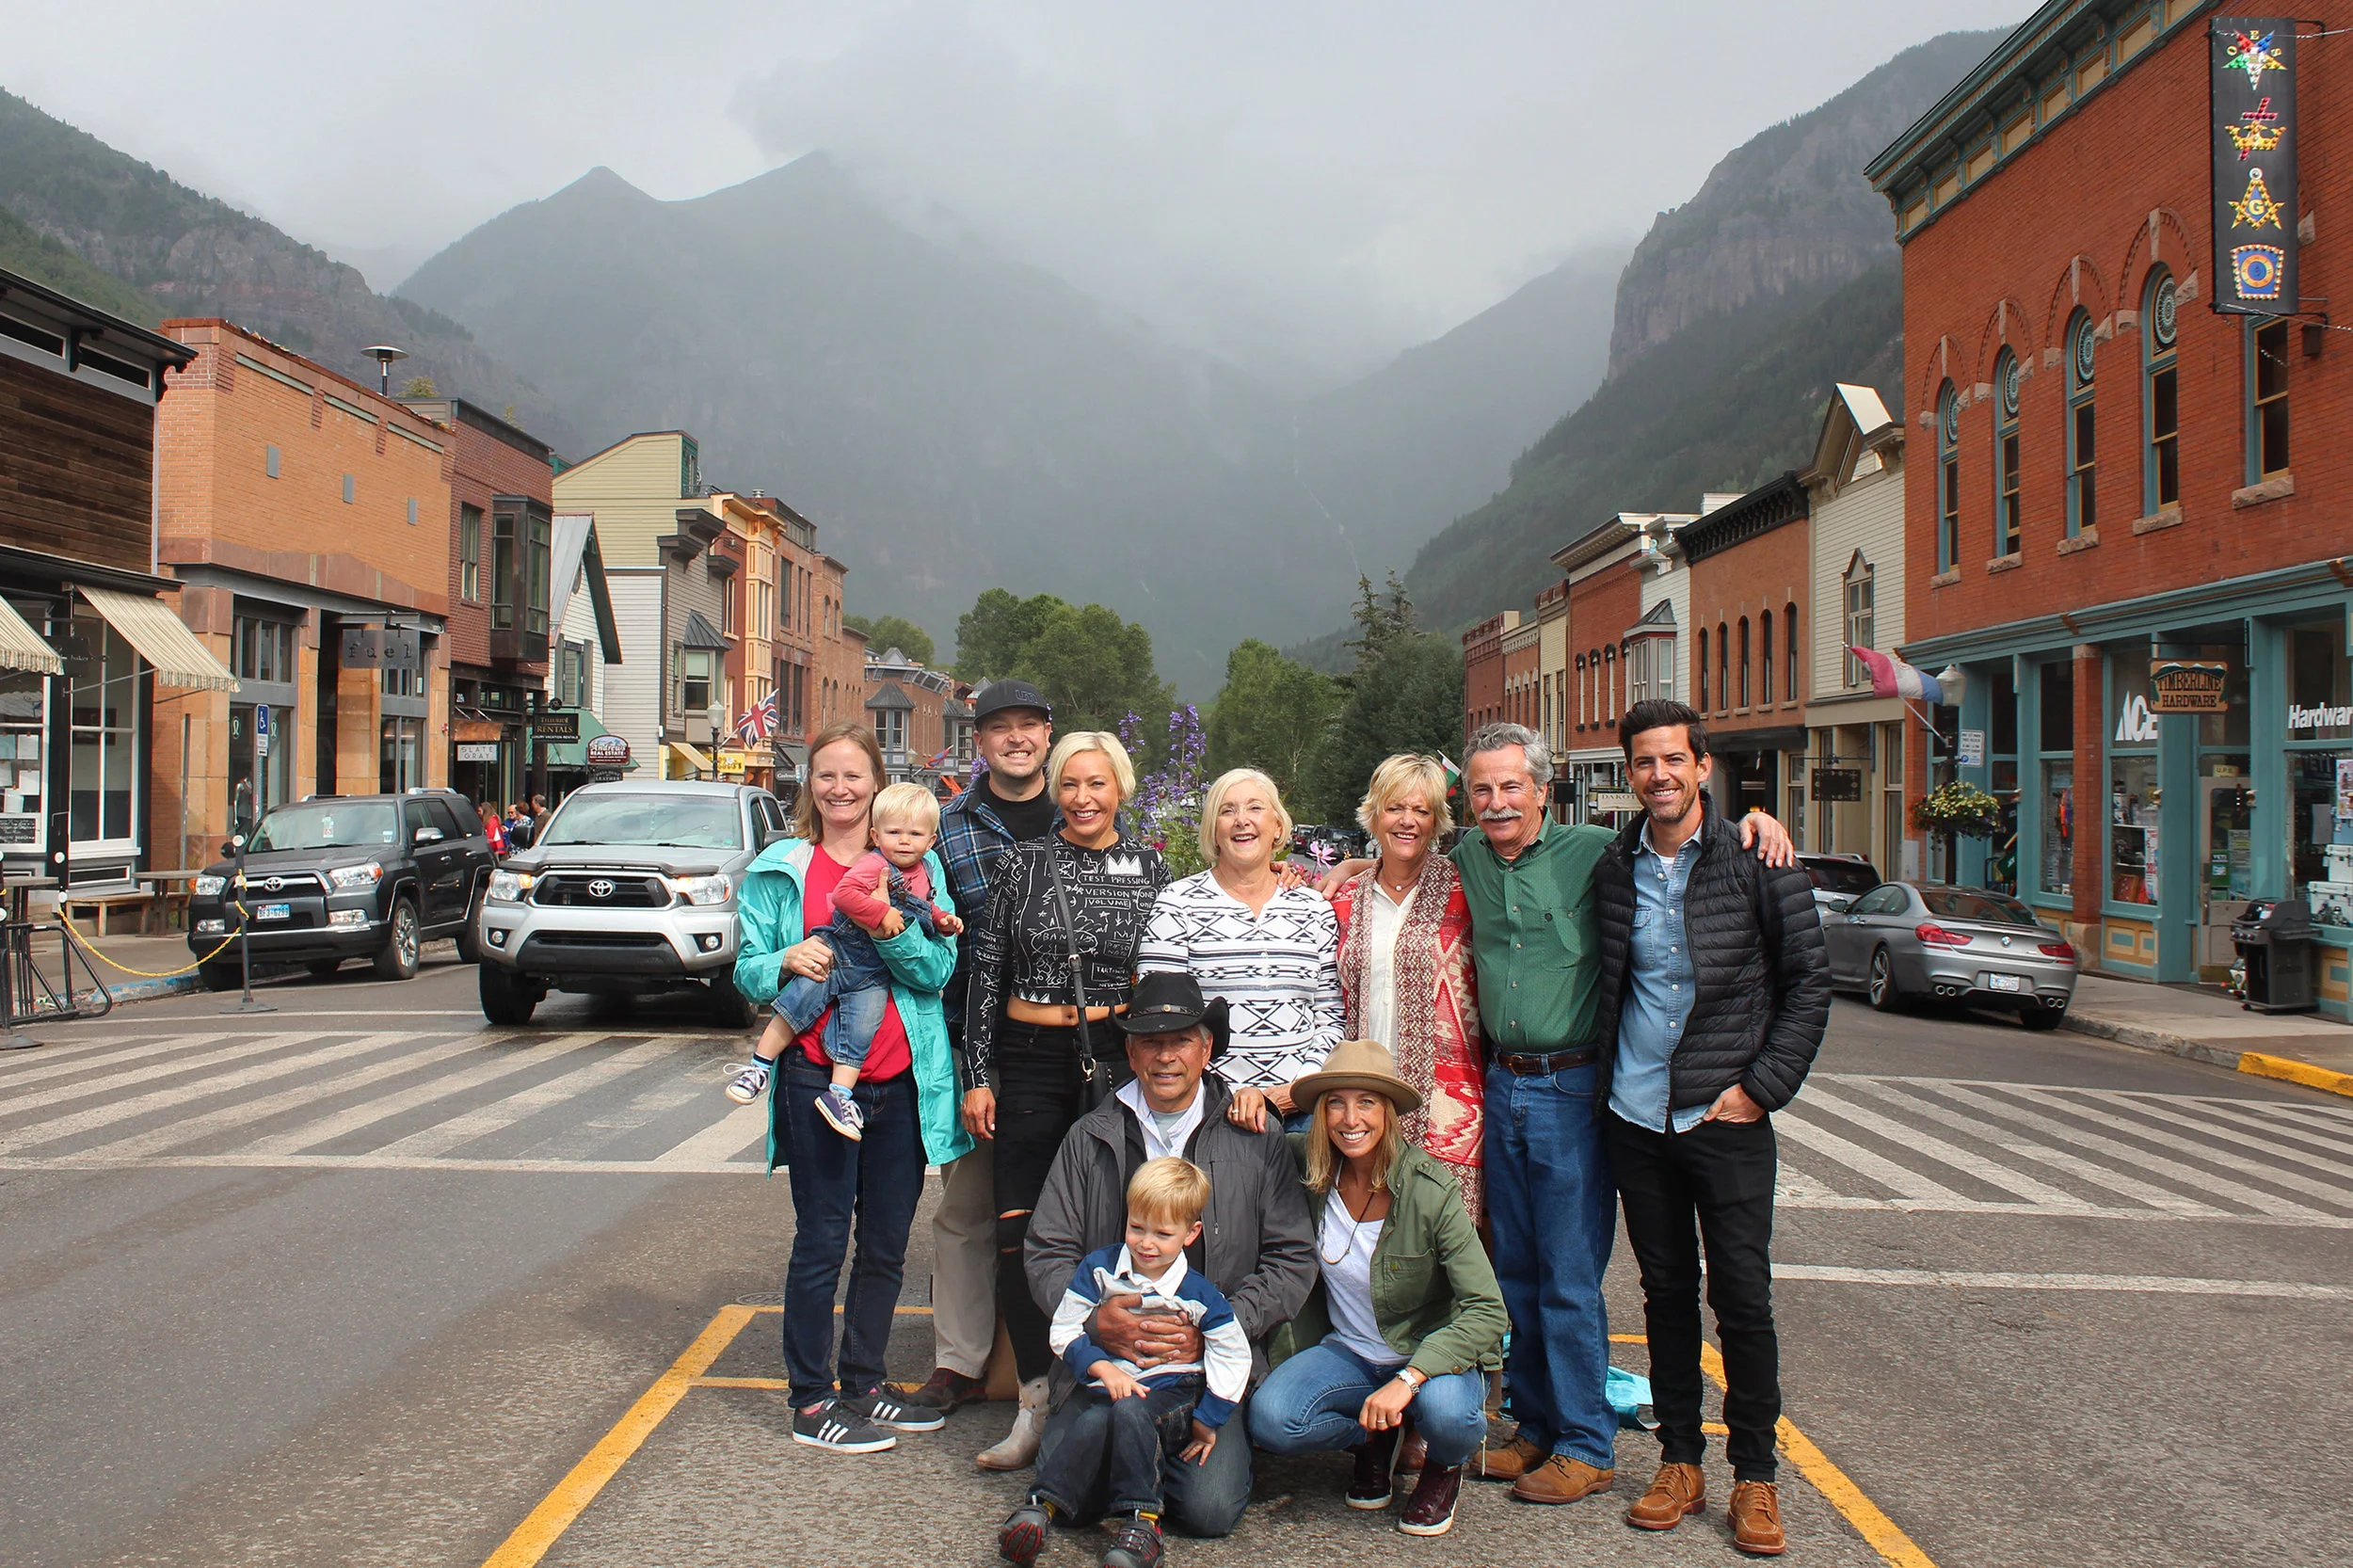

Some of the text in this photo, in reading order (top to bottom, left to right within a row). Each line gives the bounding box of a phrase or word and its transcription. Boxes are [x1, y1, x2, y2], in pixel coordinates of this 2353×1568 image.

[2249, 199, 2265, 216] G
[347, 643, 412, 659] fuel
[2156, 670, 2222, 692] TIMBERLINE
[2162, 694, 2217, 708] HARDWARE
[2115, 690, 2159, 743] ACE
[2288, 701, 2353, 729] Hardwar
[536, 725, 573, 733] RENTALS
[1111, 876, 1150, 885] PRESSING
[1085, 888, 1130, 898] VERSION
